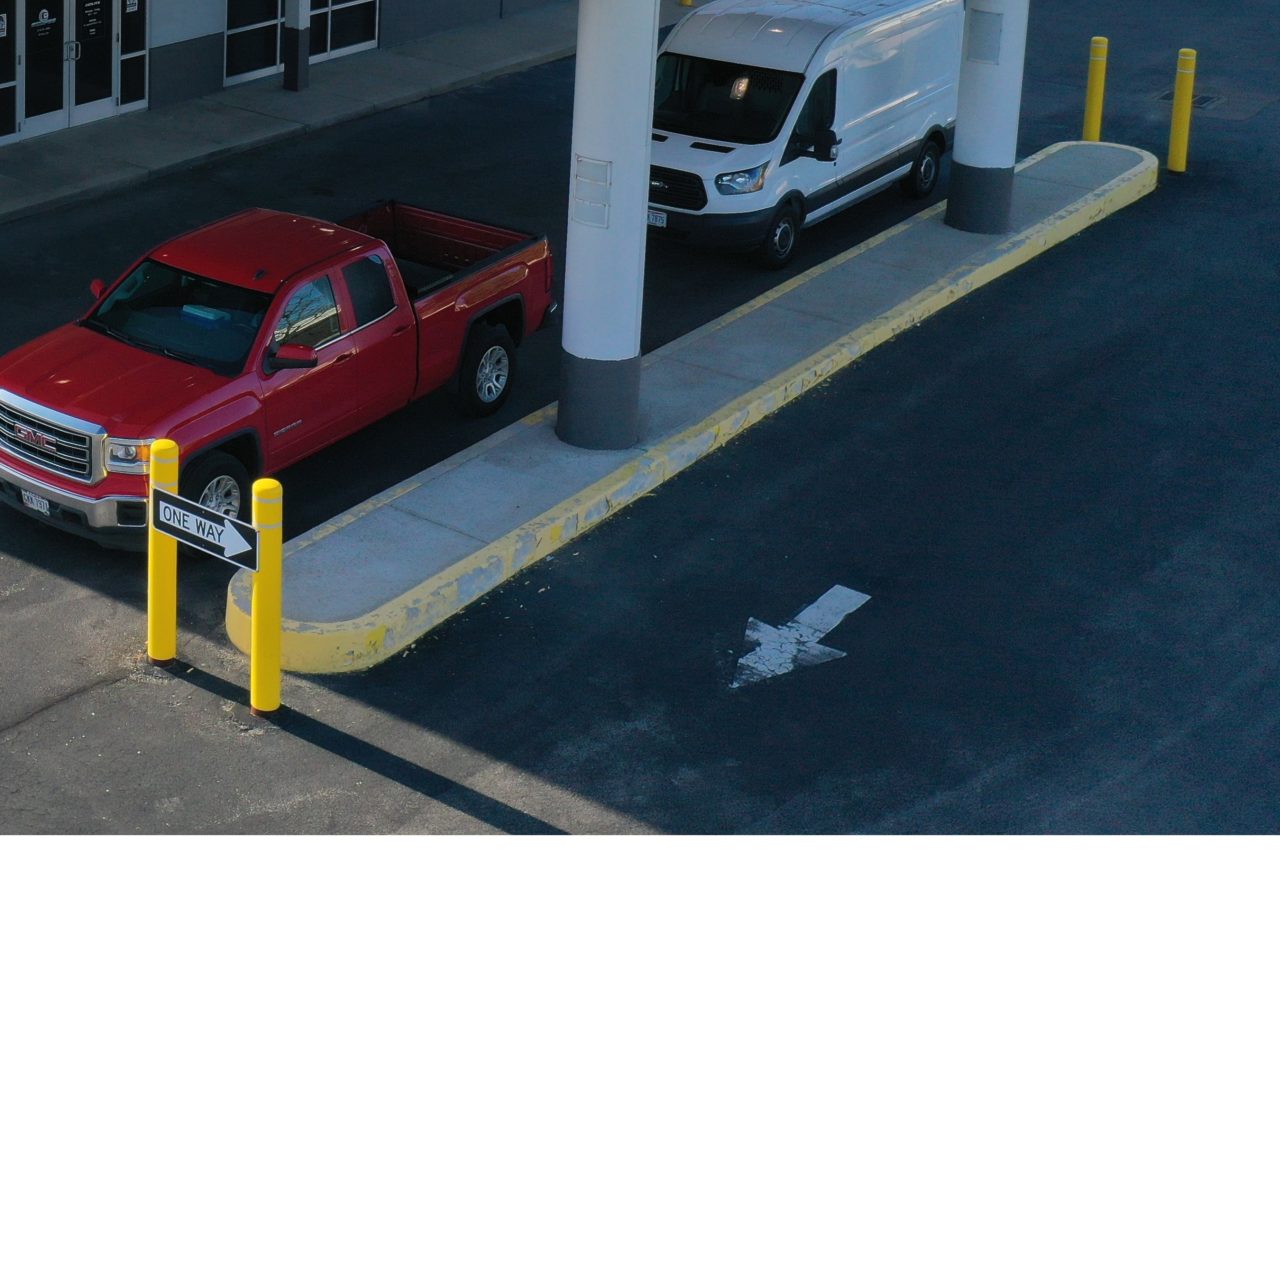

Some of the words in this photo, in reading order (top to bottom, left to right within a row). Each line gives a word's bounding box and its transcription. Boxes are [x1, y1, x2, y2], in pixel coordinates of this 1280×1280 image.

[14, 424, 57, 452] GMC
[163, 505, 190, 530] ONE
[195, 518, 224, 543] WAY
